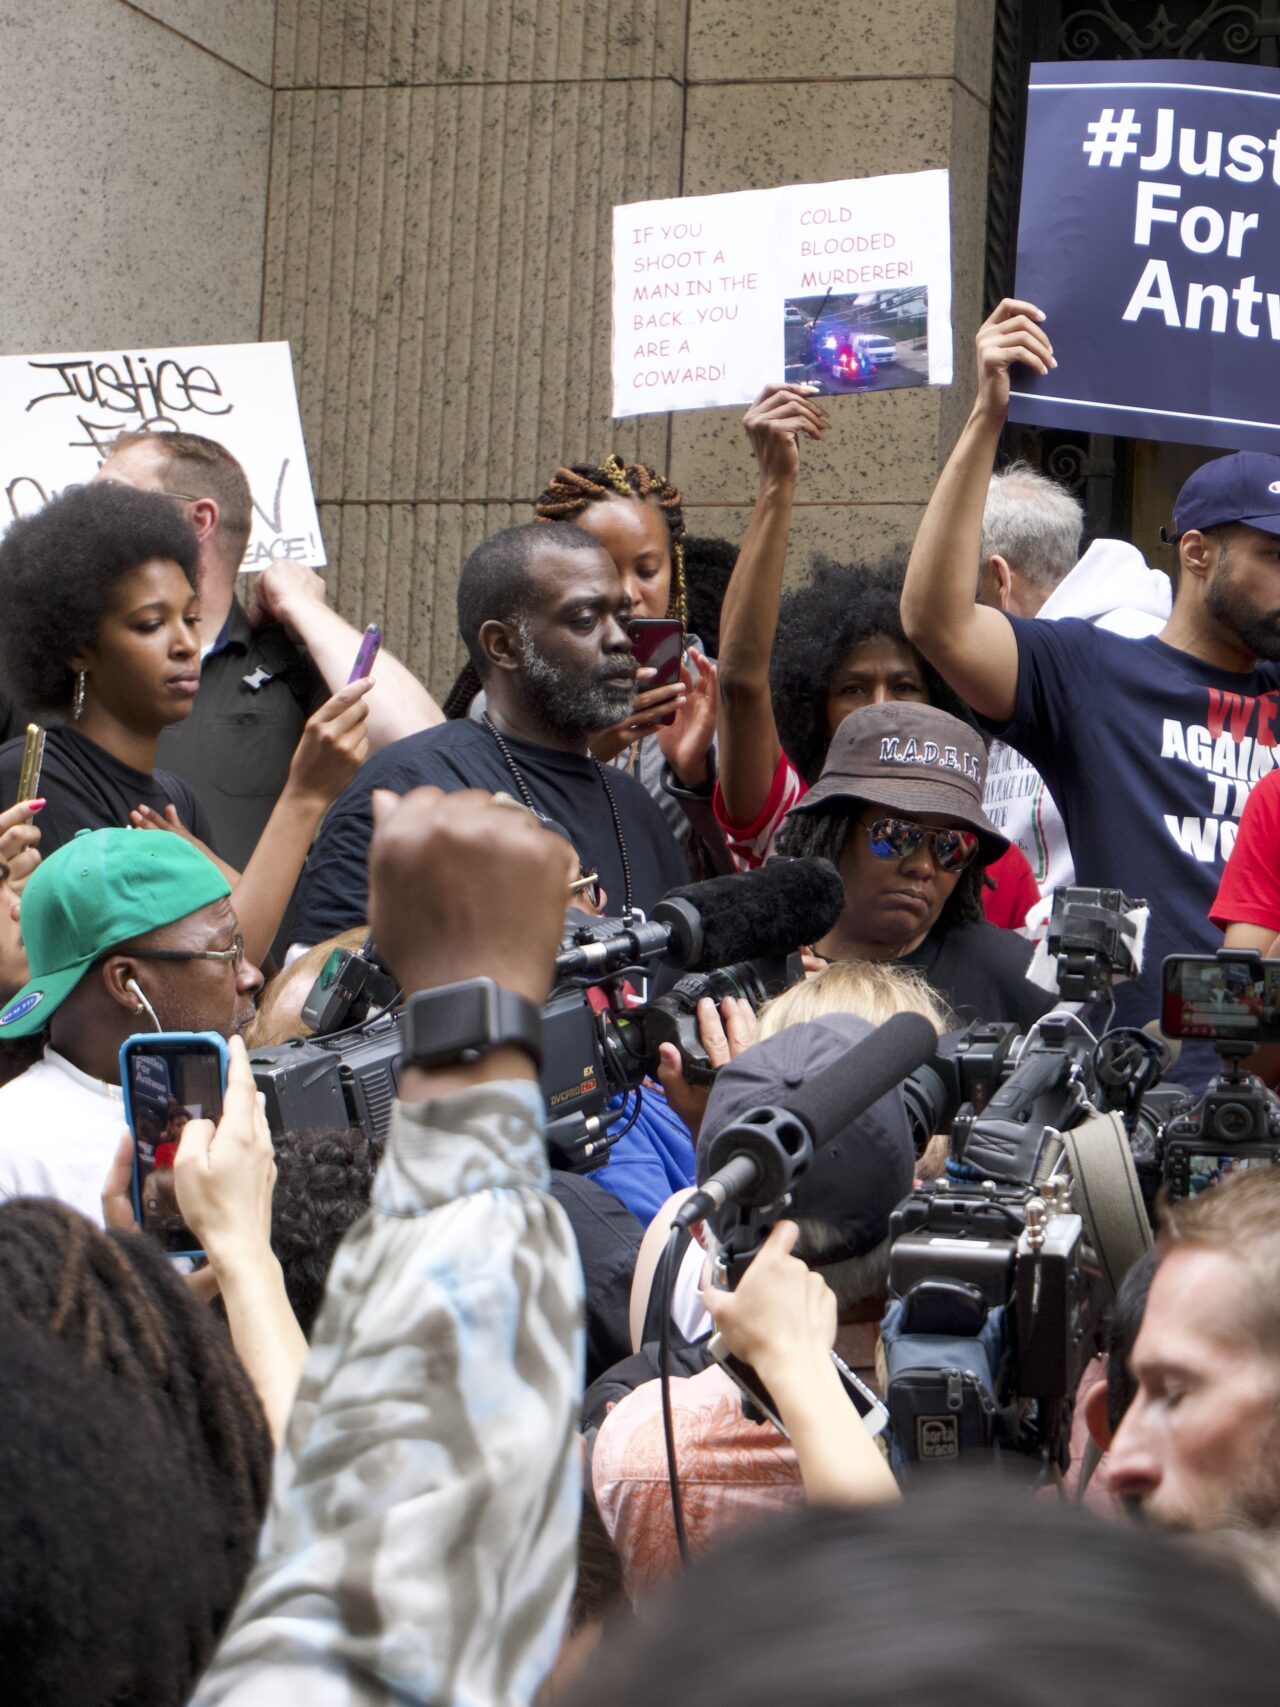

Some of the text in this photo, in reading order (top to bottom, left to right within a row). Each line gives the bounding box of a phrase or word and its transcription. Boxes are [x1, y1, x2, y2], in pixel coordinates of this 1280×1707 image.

[800, 207, 852, 225] COLD
[1133, 181, 1259, 258] For
[633, 223, 703, 244] IF YOU
[801, 233, 896, 257] BLOODED
[633, 250, 725, 273] SHOOT A
[801, 260, 913, 288] MURDERER!
[633, 273, 758, 302] MAN IN THE
[633, 339, 691, 359] ARE A
[633, 363, 726, 388] COWARD!
[1207, 687, 1280, 748] WE
[583, 1065, 594, 1077] EX
